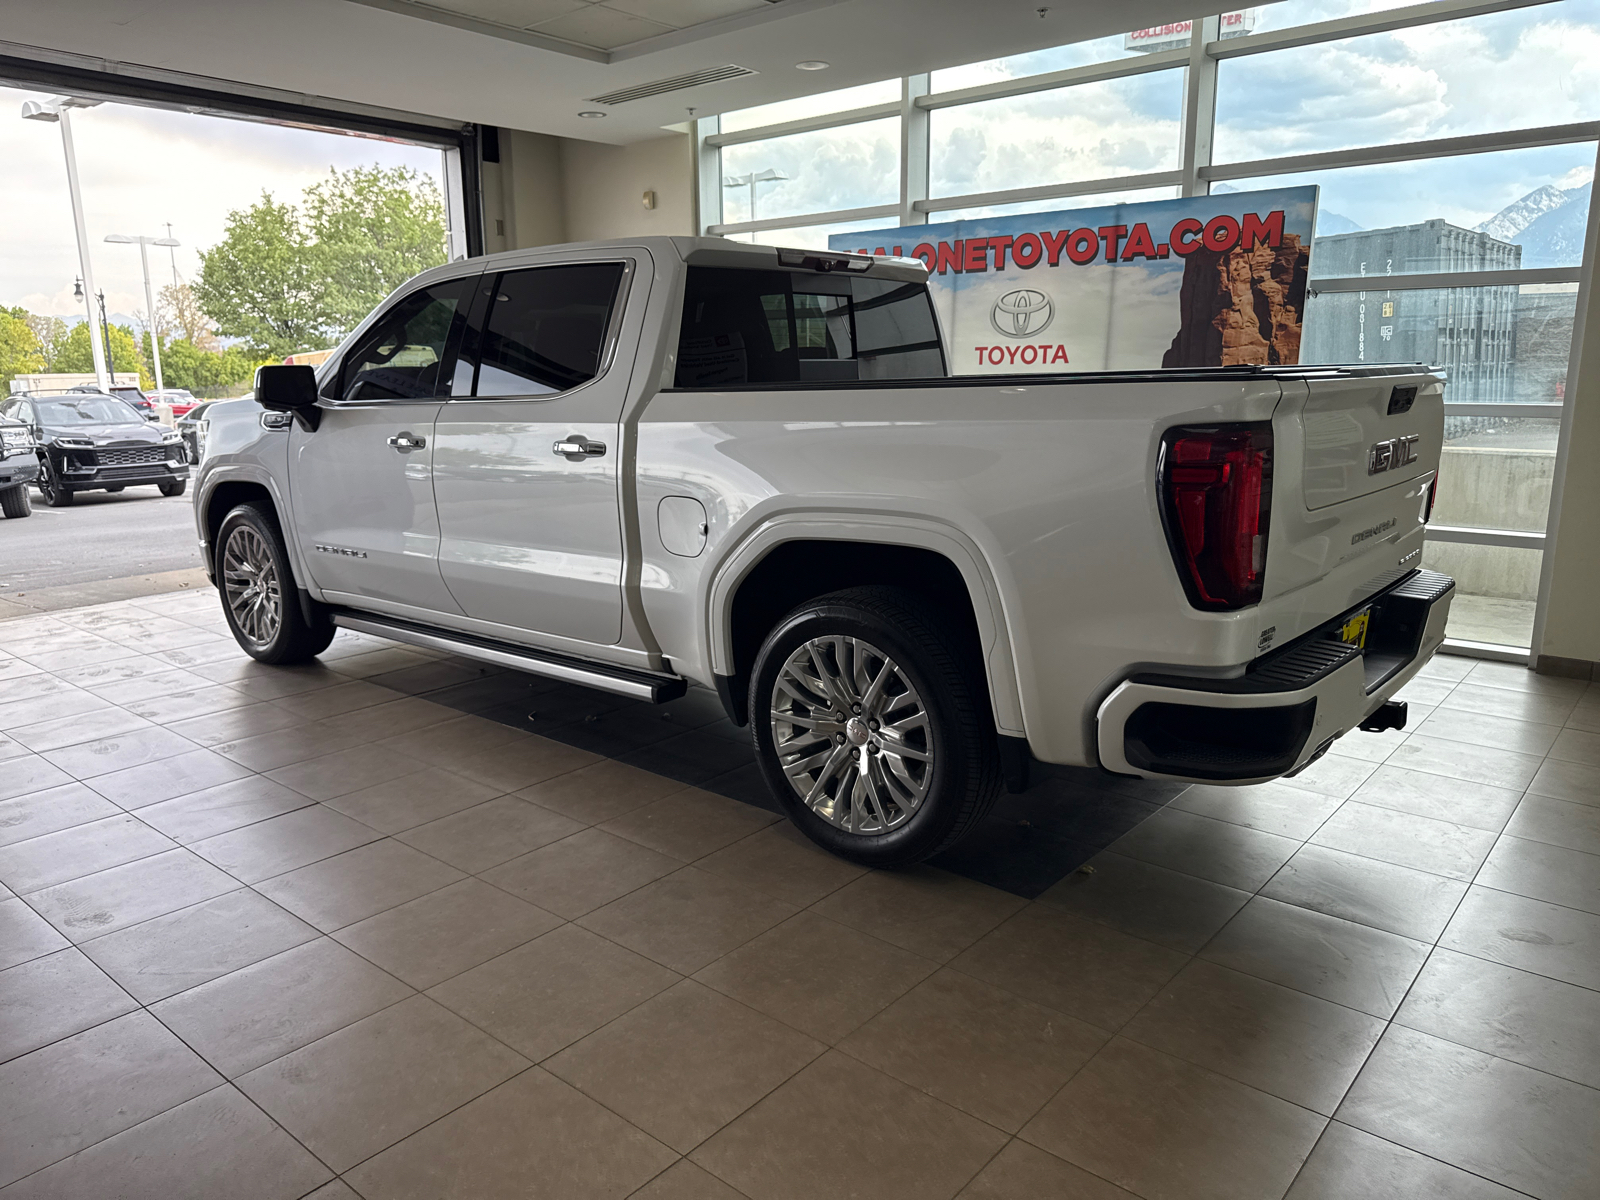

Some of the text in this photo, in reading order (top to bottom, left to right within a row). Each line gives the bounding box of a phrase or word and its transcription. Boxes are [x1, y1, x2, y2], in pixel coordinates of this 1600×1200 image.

[1131, 21, 1192, 40] COLLISION
[843, 210, 1285, 275] ONETOYOTA.COM
[975, 344, 1069, 365] TOYOTA
[1368, 434, 1419, 475] GMC
